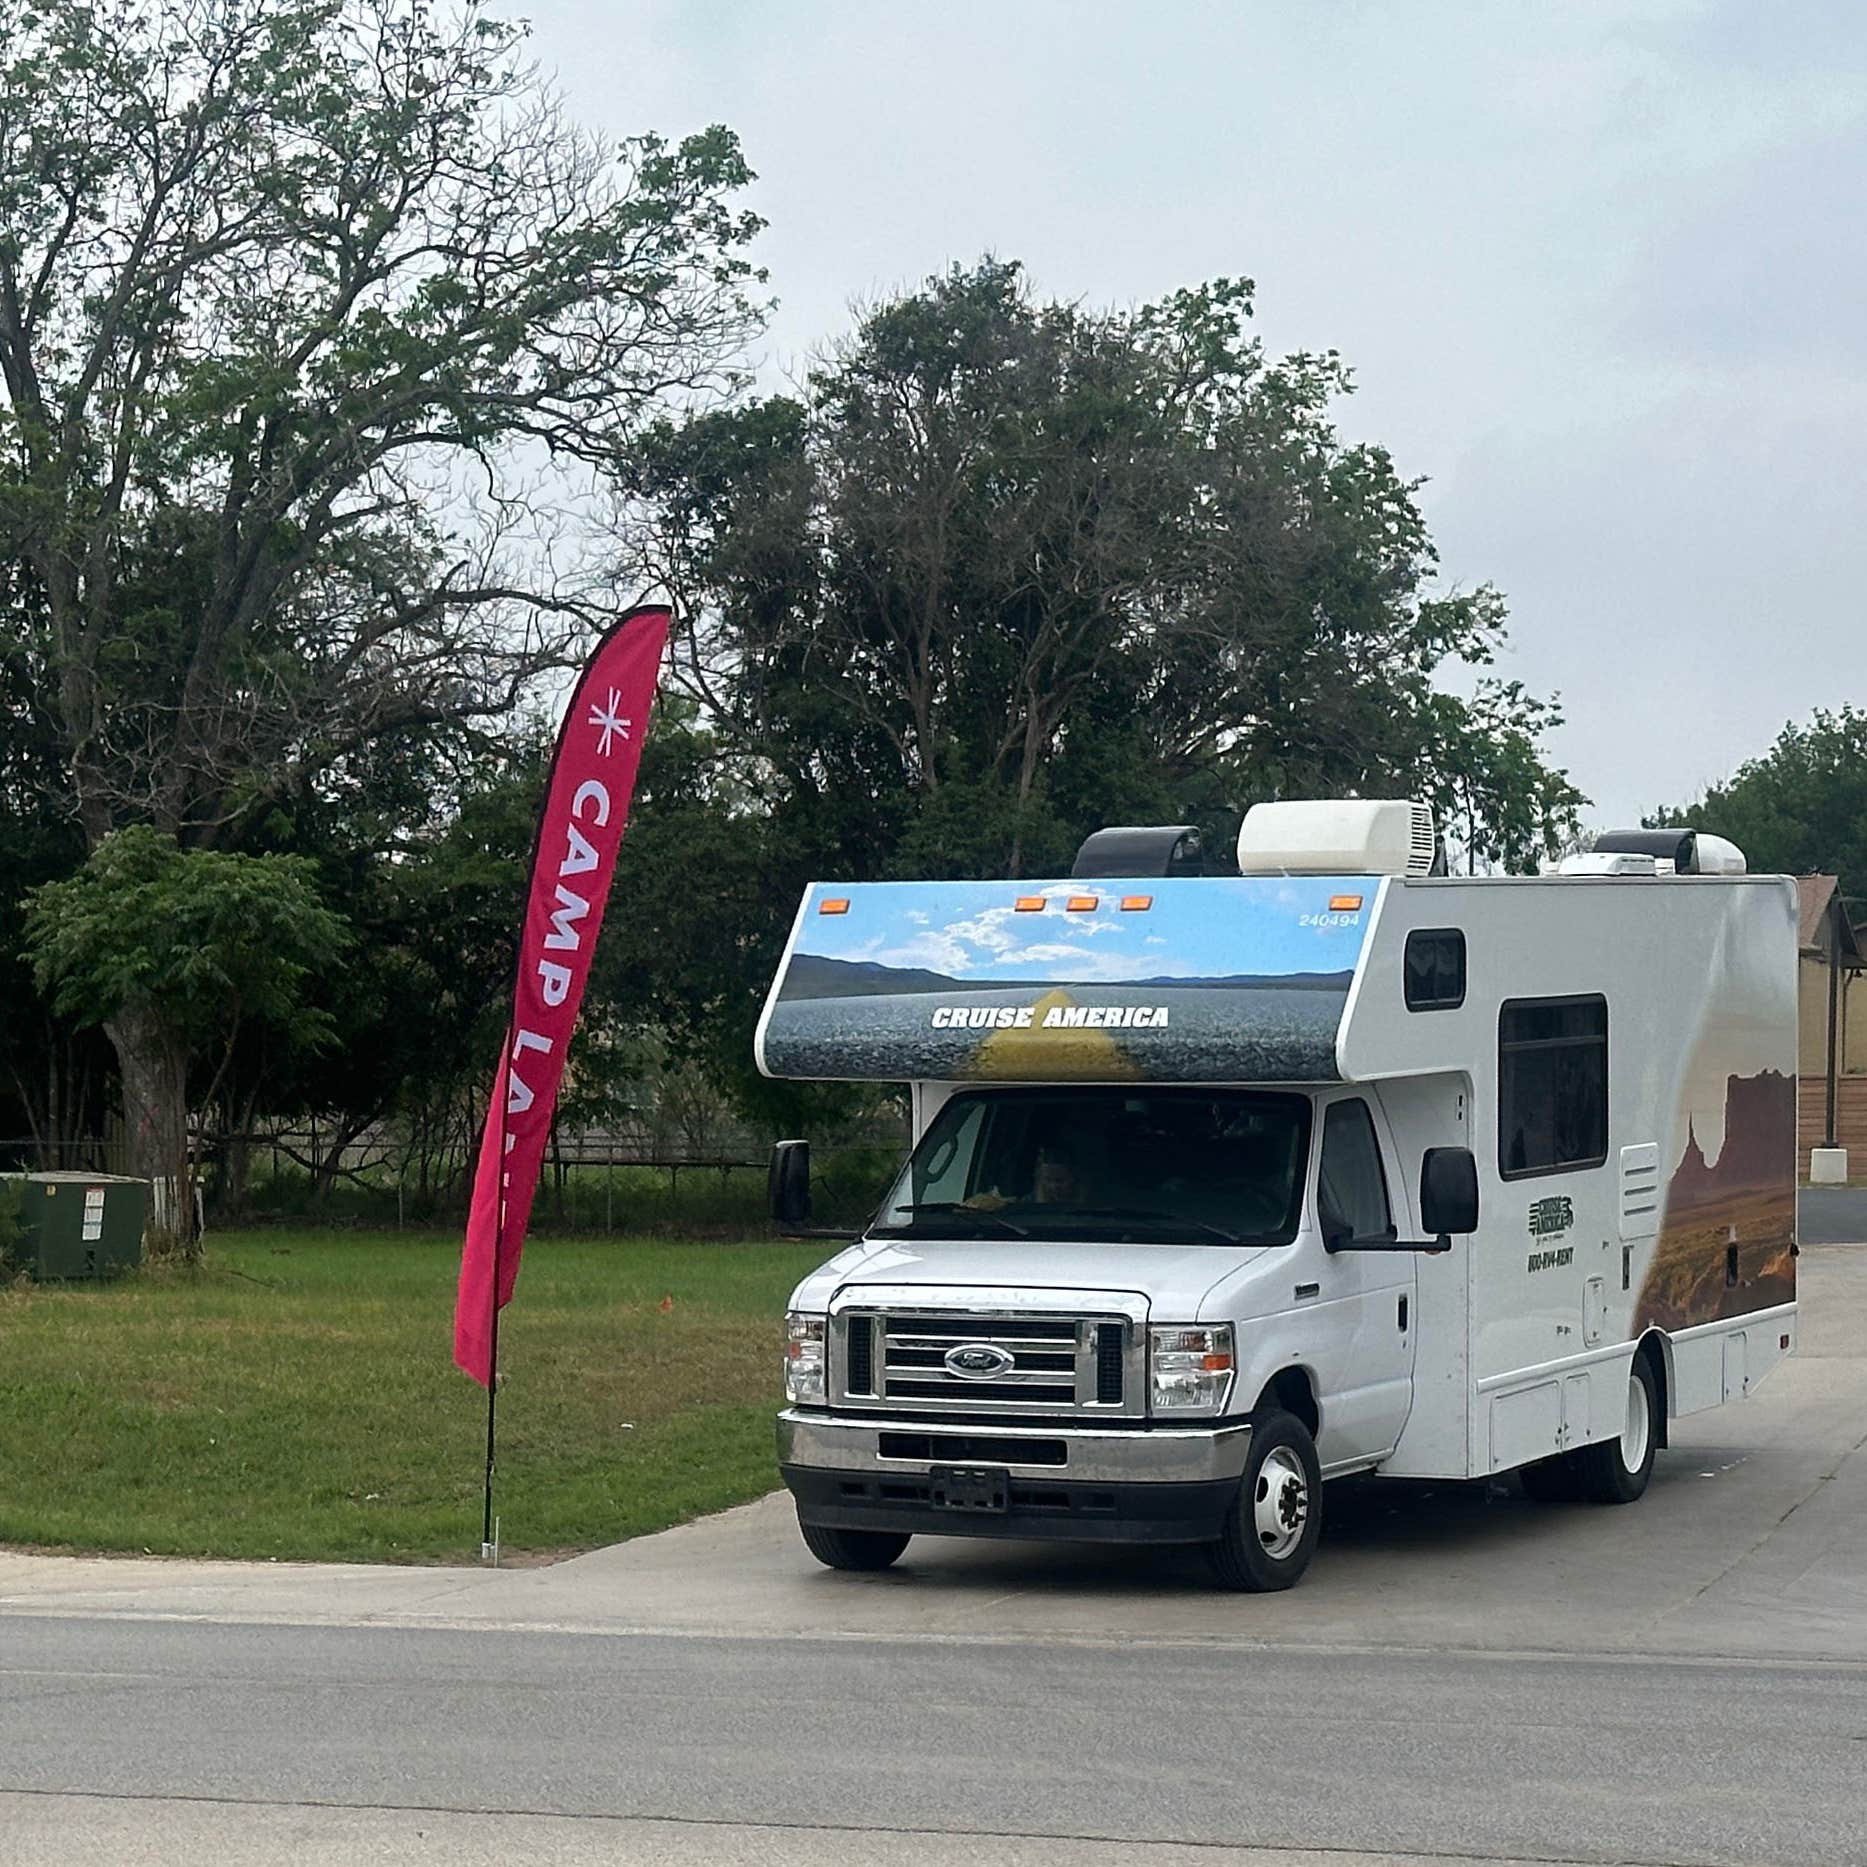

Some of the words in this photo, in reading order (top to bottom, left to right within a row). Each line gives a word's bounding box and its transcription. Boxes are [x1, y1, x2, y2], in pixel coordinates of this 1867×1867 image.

[537, 779, 611, 1007] CAMP
[1298, 913, 1360, 928] 240494
[931, 1006, 1036, 1029] CRUISE
[1041, 1006, 1169, 1029] AMERICA
